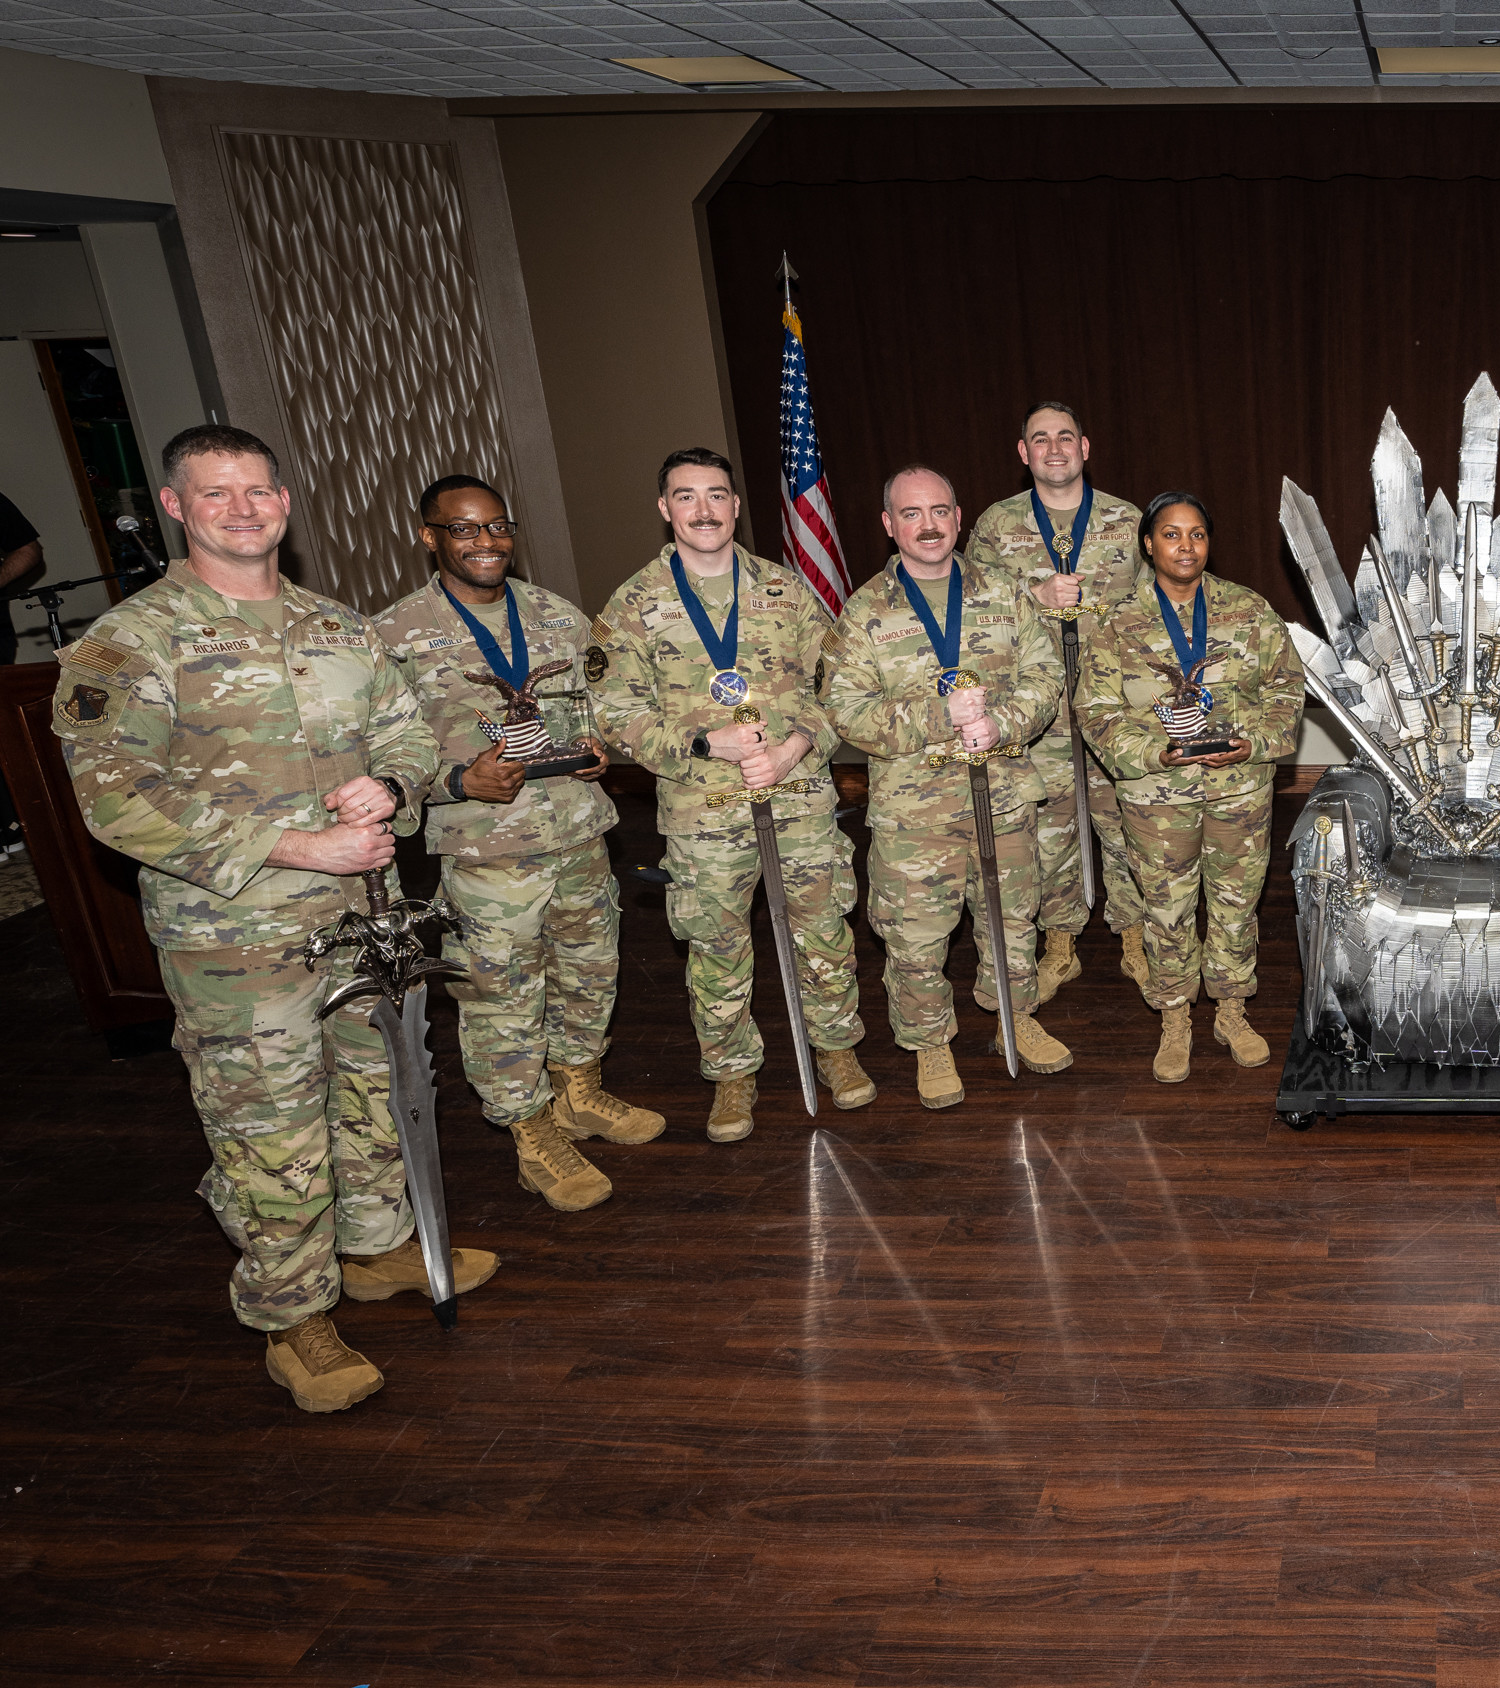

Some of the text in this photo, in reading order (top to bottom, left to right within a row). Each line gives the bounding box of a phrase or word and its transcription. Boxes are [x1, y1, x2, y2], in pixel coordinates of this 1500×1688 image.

[1012, 535, 1033, 543] COFFIN
[1111, 533, 1130, 541] FORCE
[766, 601, 779, 609] AIR
[779, 601, 799, 611] FORCE
[661, 611, 683, 620] SHIRA
[992, 615, 1002, 623] AIR
[1223, 614, 1234, 622] AIR
[1234, 609, 1256, 620] FORCE
[877, 626, 923, 643] SAMOLEWSKI
[326, 636, 340, 645] AIR
[341, 636, 365, 646] FORCE
[193, 640, 250, 654] RICHARDS
